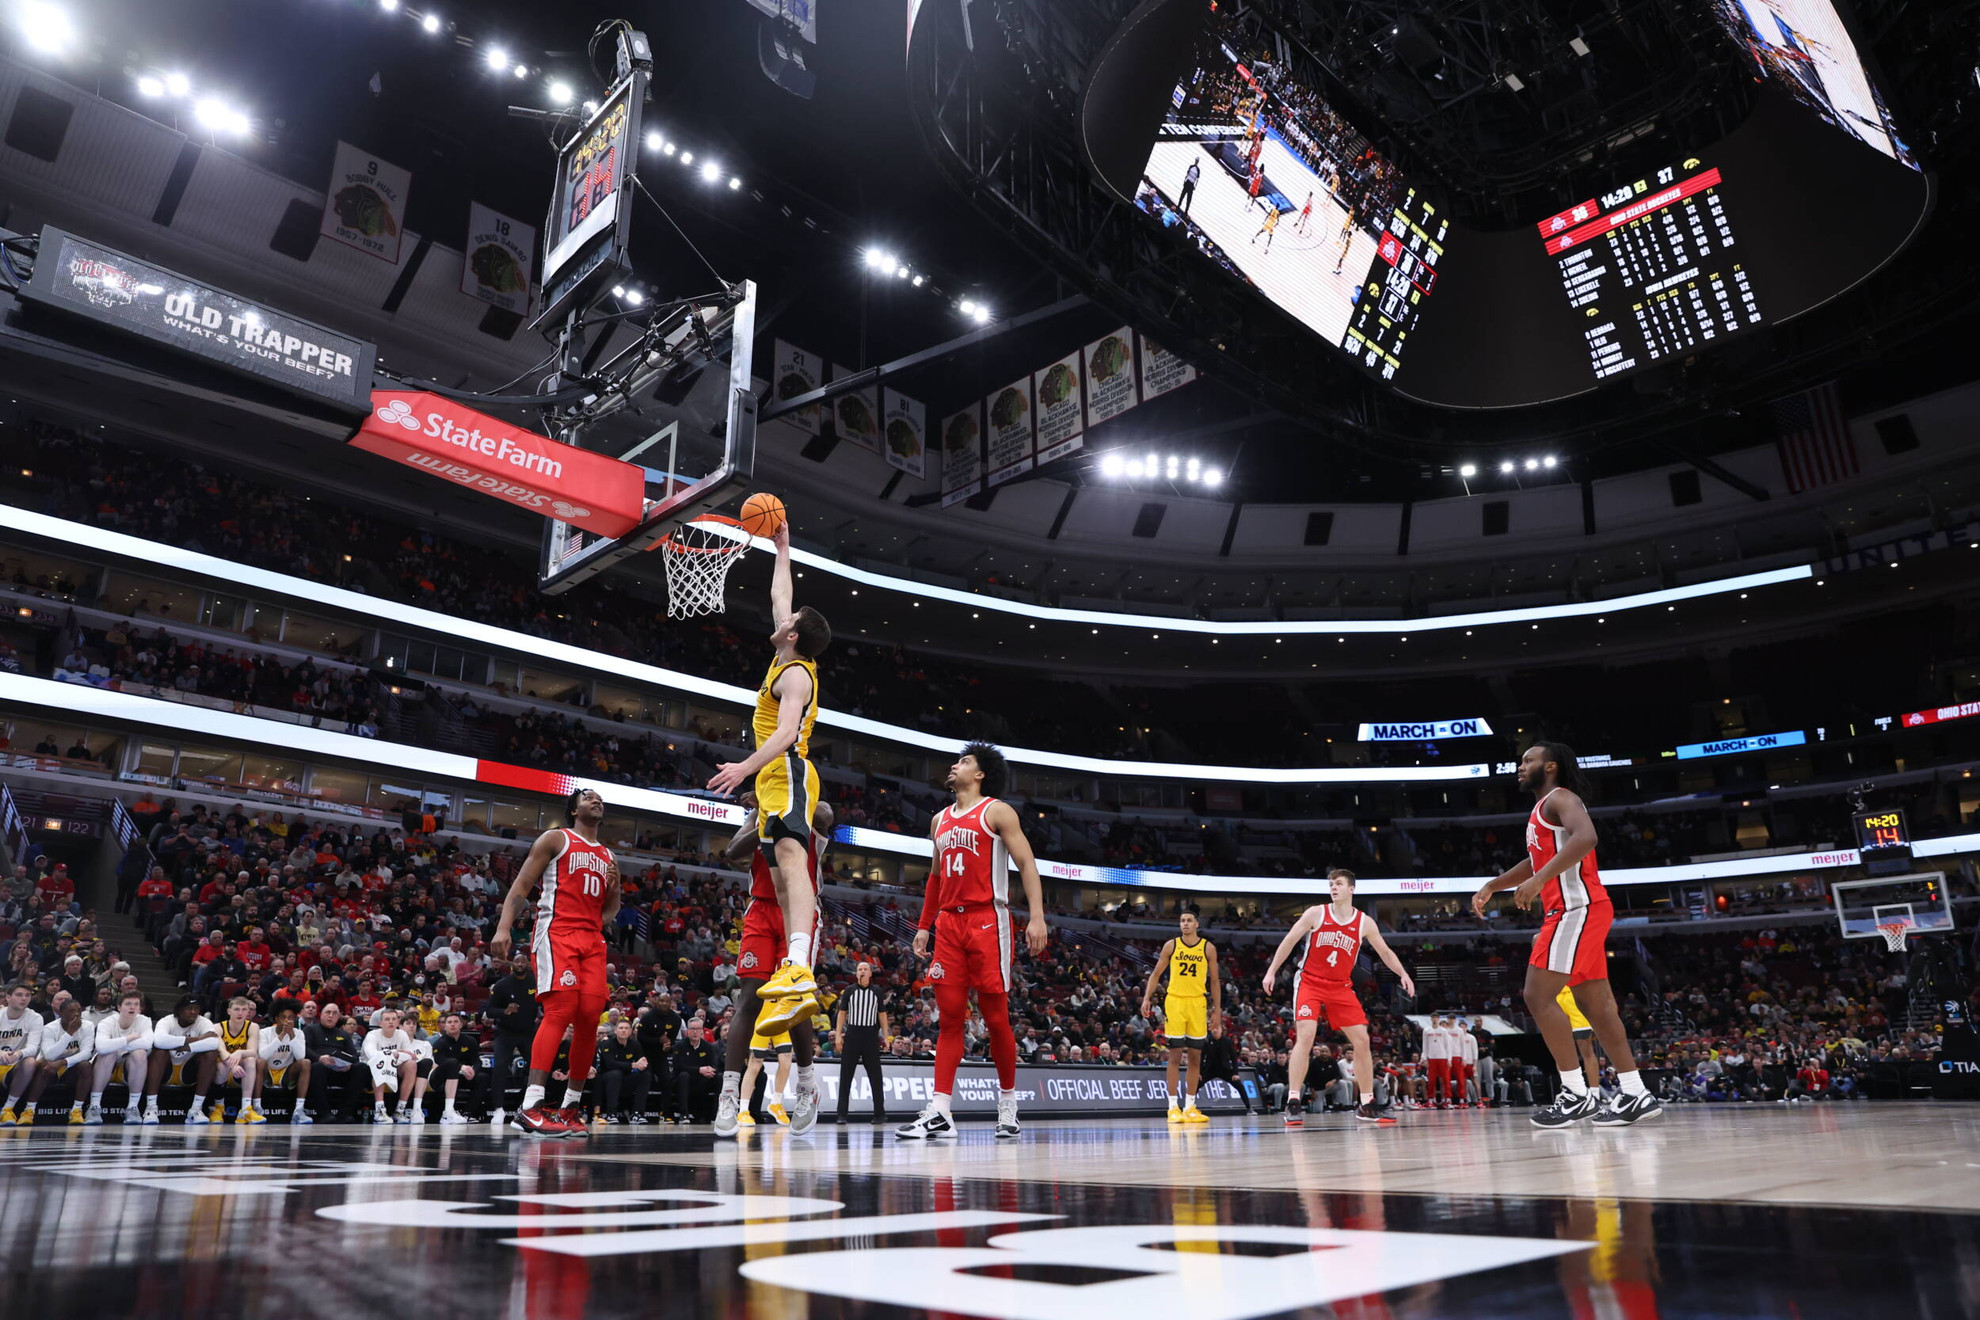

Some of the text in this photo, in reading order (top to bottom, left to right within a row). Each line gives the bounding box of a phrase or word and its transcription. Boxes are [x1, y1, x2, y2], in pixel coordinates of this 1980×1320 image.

[368, 161, 378, 176] 9
[1657, 166, 1674, 185] 37
[346, 174, 376, 185] BOBBY
[1626, 202, 1648, 218] STATE
[494, 218, 510, 236] 18
[1386, 267, 1411, 298] 14:20
[164, 294, 352, 377] OLD TRAPPER
[163, 314, 335, 380] WHAT'S YOUR BEEF?
[1938, 706, 1960, 720] OHIO
[1373, 724, 1435, 738] MARCH
[1450, 720, 1477, 735] ON
[1702, 736, 1778, 754] MARCH ON
[1496, 762, 1517, 774] 2:56
[688, 802, 728, 820] meijer
[68, 822, 89, 834] 122
[1865, 814, 1900, 828] 14:20
[950, 826, 980, 856] STATE
[1876, 828, 1900, 847] 14
[568, 852, 590, 875] OHIO
[946, 852, 965, 878] 14
[1812, 851, 1854, 866] meijer
[1052, 864, 1082, 878] meijer
[582, 873, 600, 898] 10
[1400, 878, 1435, 893] meijer
[1316, 930, 1356, 956] OHIO STATE
[1175, 950, 1204, 962] Iowa
[1326, 950, 1338, 968] 4
[1178, 962, 1198, 977] 24
[959, 1090, 996, 1101] YOUR
[1047, 1078, 1105, 1100] OFFICIAL
[1110, 1079, 1142, 1100] BEEF
[1146, 1080, 1188, 1100] JERY
[1204, 1081, 1227, 1099] THE
